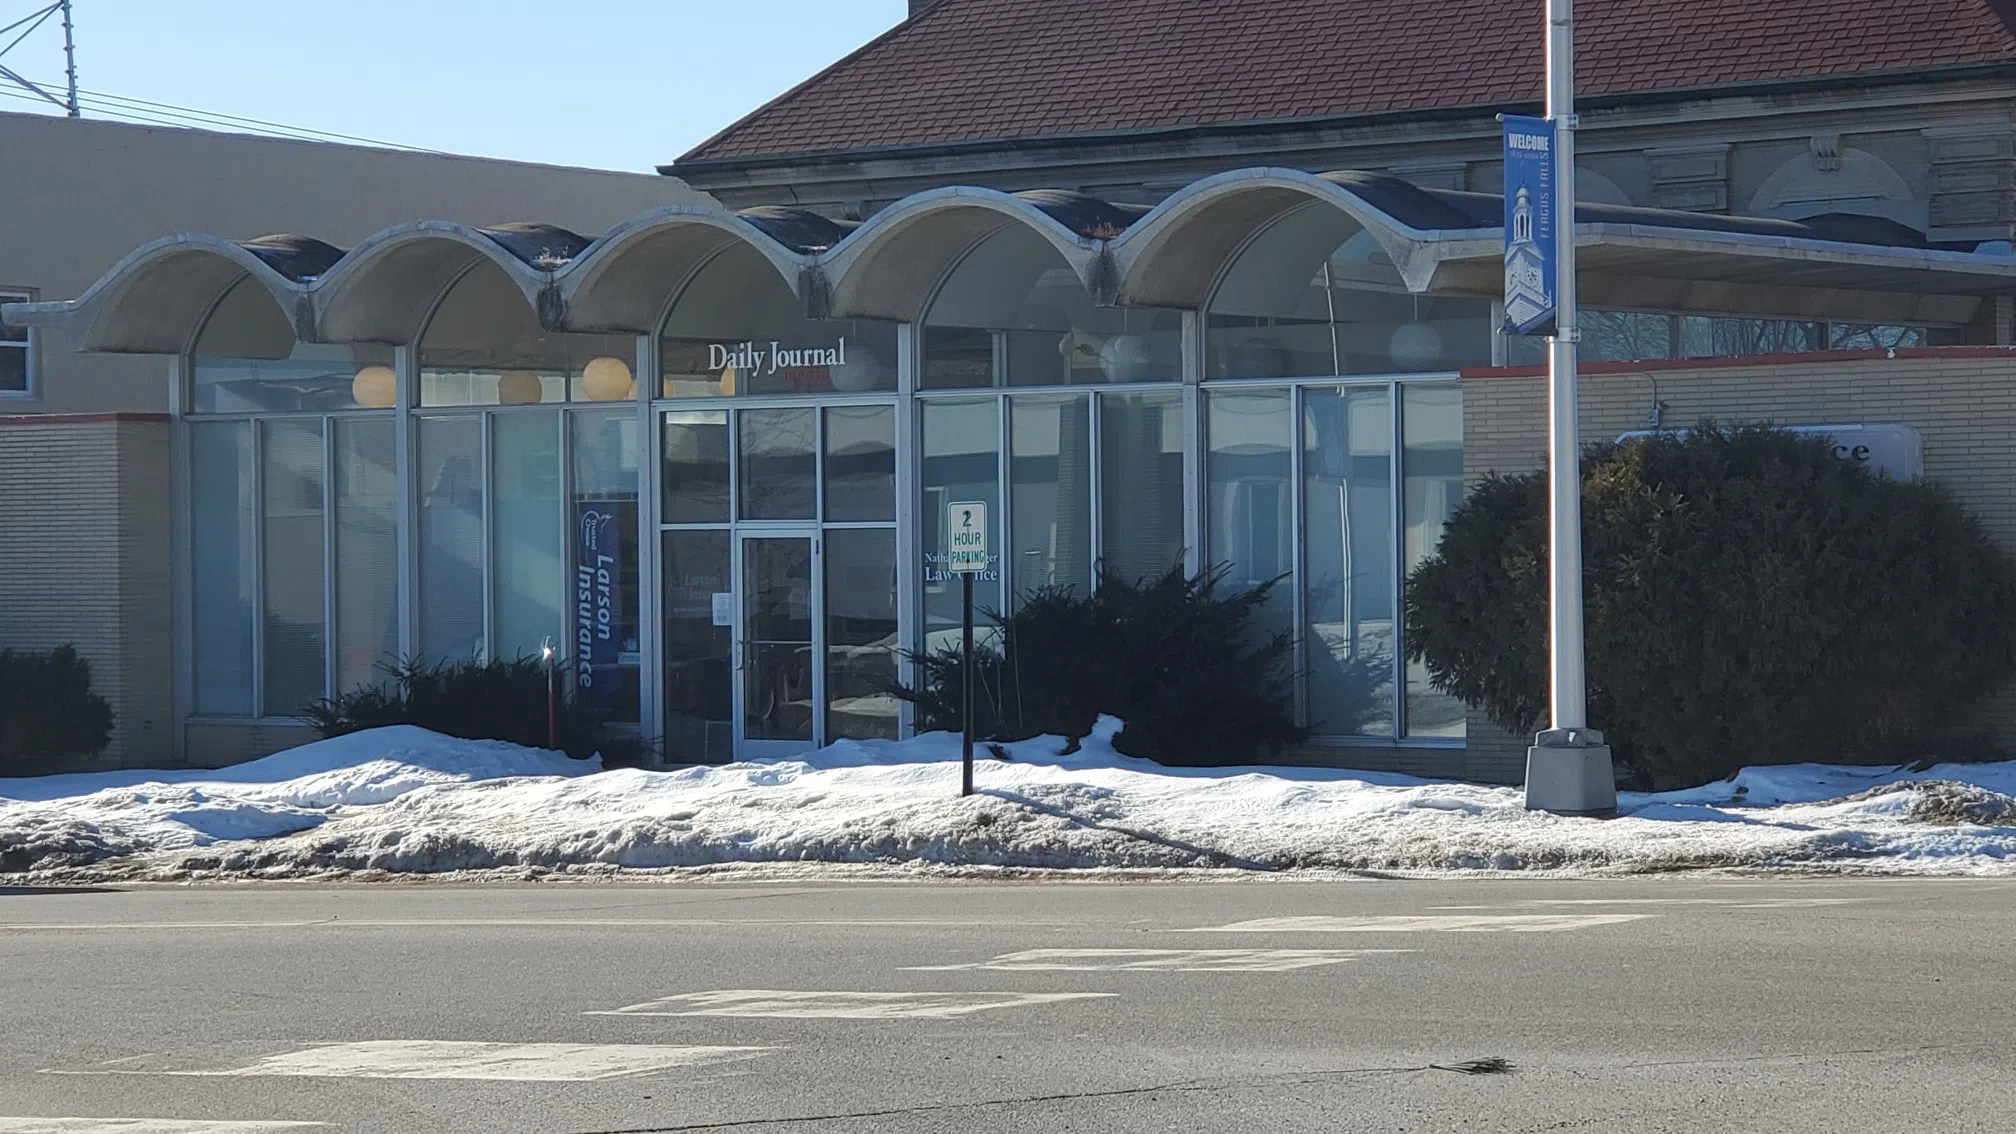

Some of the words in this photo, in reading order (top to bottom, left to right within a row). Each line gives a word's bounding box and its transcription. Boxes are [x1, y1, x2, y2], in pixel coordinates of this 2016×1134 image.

[1509, 133, 1549, 151] WELCOME
[1540, 152, 1549, 188] FALLS
[1540, 192, 1550, 239] FERGUS
[708, 340, 766, 377] Daily
[767, 336, 846, 375] Journal
[962, 510, 972, 527] 2
[954, 532, 982, 546] HOUR
[952, 550, 984, 564] PARKING
[925, 566, 953, 581] Law
[597, 554, 613, 640] Larson
[579, 565, 595, 688] Insurance
